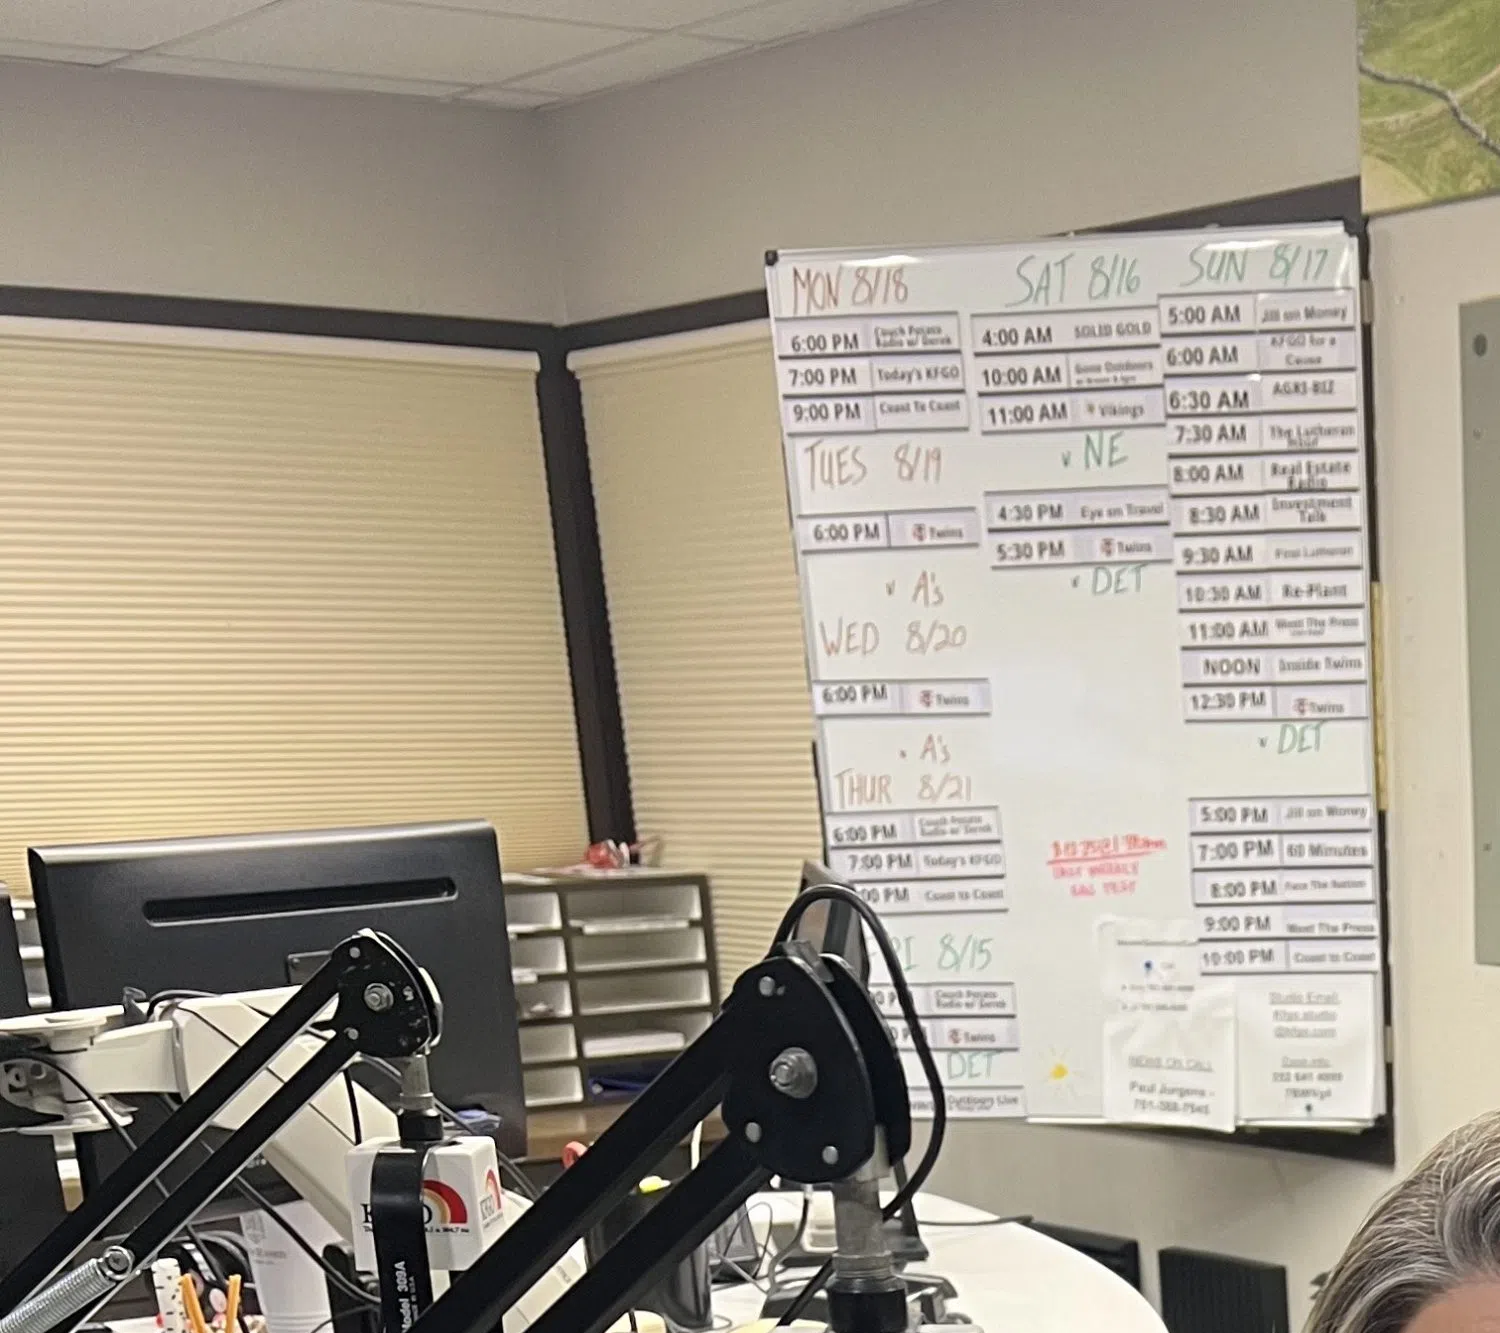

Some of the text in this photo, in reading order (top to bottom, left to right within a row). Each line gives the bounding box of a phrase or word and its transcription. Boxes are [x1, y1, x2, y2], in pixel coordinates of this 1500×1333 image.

[1179, 242, 1329, 287] SUN 8/17
[793, 264, 909, 316] MON 8/18
[1004, 252, 1141, 308] SAT 8/16
[1168, 306, 1206, 325] 5:00
[1211, 304, 1241, 324] AM
[791, 332, 859, 353] 6:00 PM
[982, 321, 1152, 346] 4:00 AM SOLID GOLD
[1167, 345, 1239, 366] 6:00 AM
[789, 365, 960, 387] 7:00 PM Today's KFGO
[982, 367, 1028, 387] 10:00
[1032, 365, 1062, 384] AM
[1169, 390, 1211, 410] 6:30
[1217, 389, 1250, 410] AM
[793, 403, 829, 422] 9:00
[834, 402, 861, 421] PM
[879, 401, 911, 414] Coast
[929, 399, 961, 412] Coast
[988, 403, 1035, 426] 11:00
[1039, 401, 1069, 421] AM
[1175, 424, 1212, 444] 7:30
[1217, 423, 1247, 442] AM
[1083, 430, 1129, 471] NE
[804, 438, 942, 491] TUES 8/19
[1173, 463, 1244, 483] 8:00 AM
[998, 504, 1032, 522] 4:30
[1037, 503, 1064, 521] PM
[1189, 504, 1260, 525] 8:30 AM
[813, 522, 849, 542] 6:00
[853, 522, 880, 541] PM
[996, 542, 1033, 561] 5:30
[1037, 541, 1065, 560] PM
[1182, 546, 1220, 566] 9:30
[1224, 545, 1254, 564] AM
[911, 569, 945, 608] A's
[1091, 562, 1149, 597] DET
[1234, 583, 1262, 602] AM
[818, 615, 968, 657] WED 8/20
[1189, 621, 1235, 642] 11:00
[1239, 620, 1269, 639] AM
[1202, 657, 1261, 676] NOON
[822, 685, 857, 705] 6:00
[862, 683, 888, 701] PM
[1190, 692, 1236, 711] 12:30
[1239, 691, 1266, 708] PM
[1277, 719, 1327, 755] DET
[834, 767, 973, 809] THUR 8/21
[1201, 806, 1237, 823] 5:00
[1241, 805, 1269, 823] PM
[832, 825, 867, 843] 6:00
[871, 823, 898, 841] PM
[1198, 842, 1239, 861] 7:00
[1243, 839, 1274, 857] PM
[848, 853, 883, 871] 7:00
[887, 852, 913, 869] PM
[883, 886, 910, 903] PM
[1211, 880, 1278, 899] 8:00 PM
[1204, 915, 1271, 932] 9:00 PM
[936, 932, 996, 973] 8/15
[1203, 948, 1275, 967] 10:00 PM
[946, 1048, 1005, 1080] DET
[394, 1261, 409, 1293] 309A
